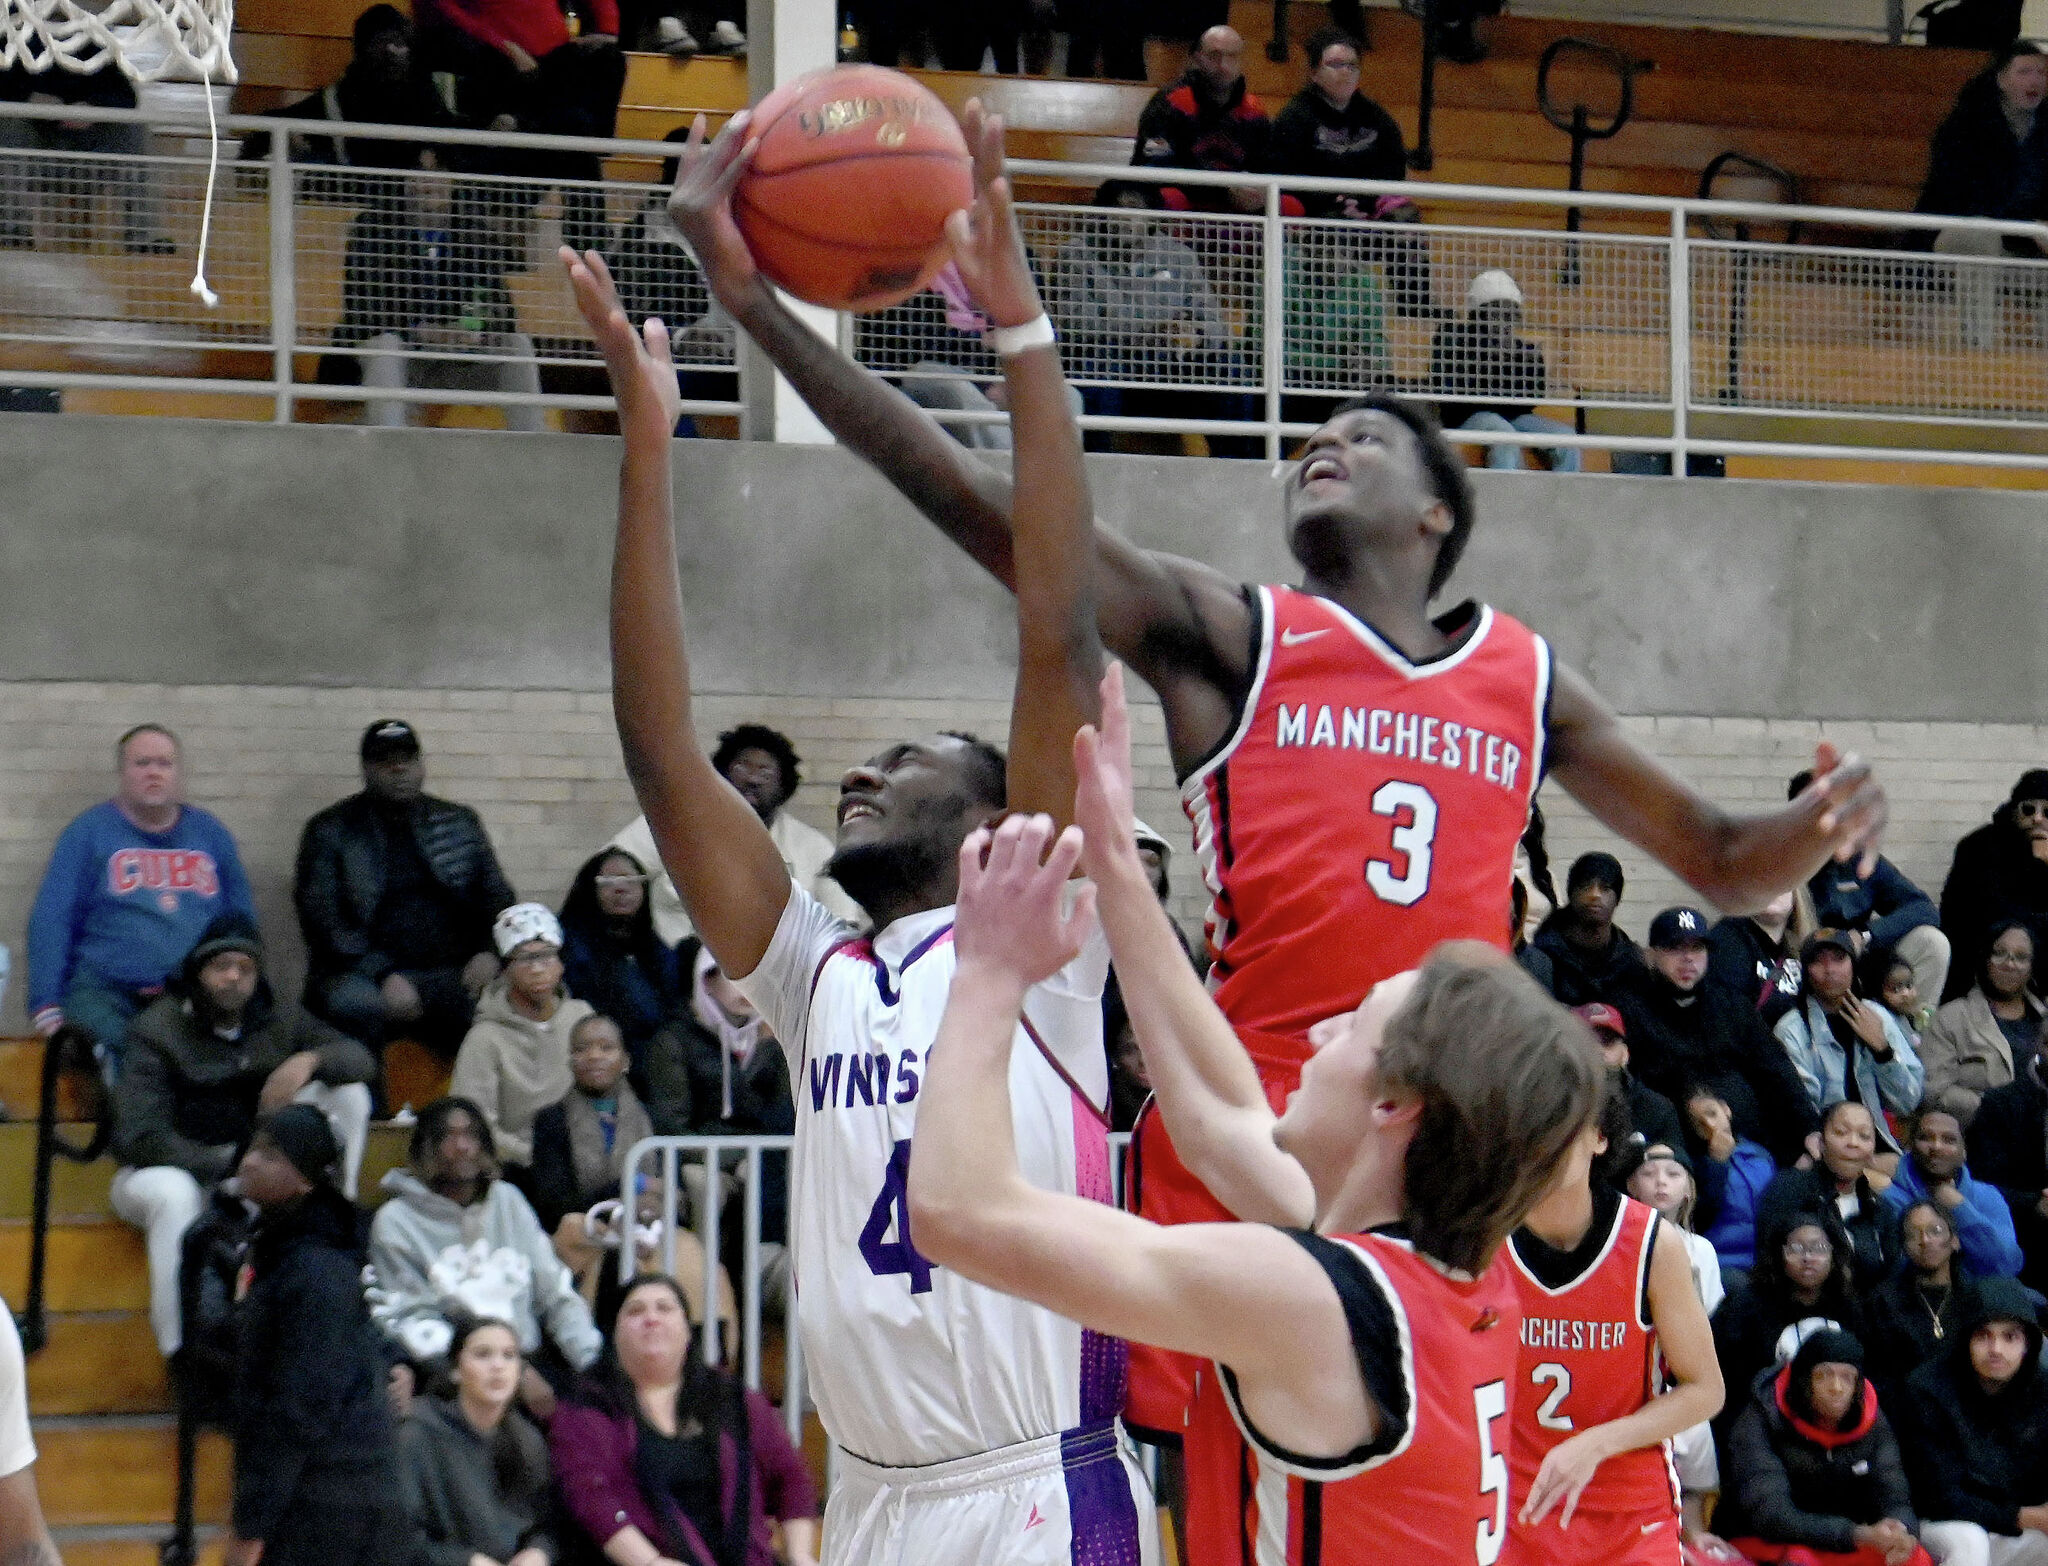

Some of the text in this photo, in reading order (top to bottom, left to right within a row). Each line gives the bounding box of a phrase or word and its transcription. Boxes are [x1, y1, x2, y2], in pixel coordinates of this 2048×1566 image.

[1276, 702, 1522, 791] MANCHESTER
[107, 848, 220, 898] CUBS
[1364, 779, 1439, 907] 3
[810, 1044, 933, 1113] WINDS
[858, 1138, 940, 1294] 4
[1519, 1316, 1627, 1351] NCHESTER
[1531, 1362, 1574, 1432] 2
[1473, 1379, 1509, 1566] 5
